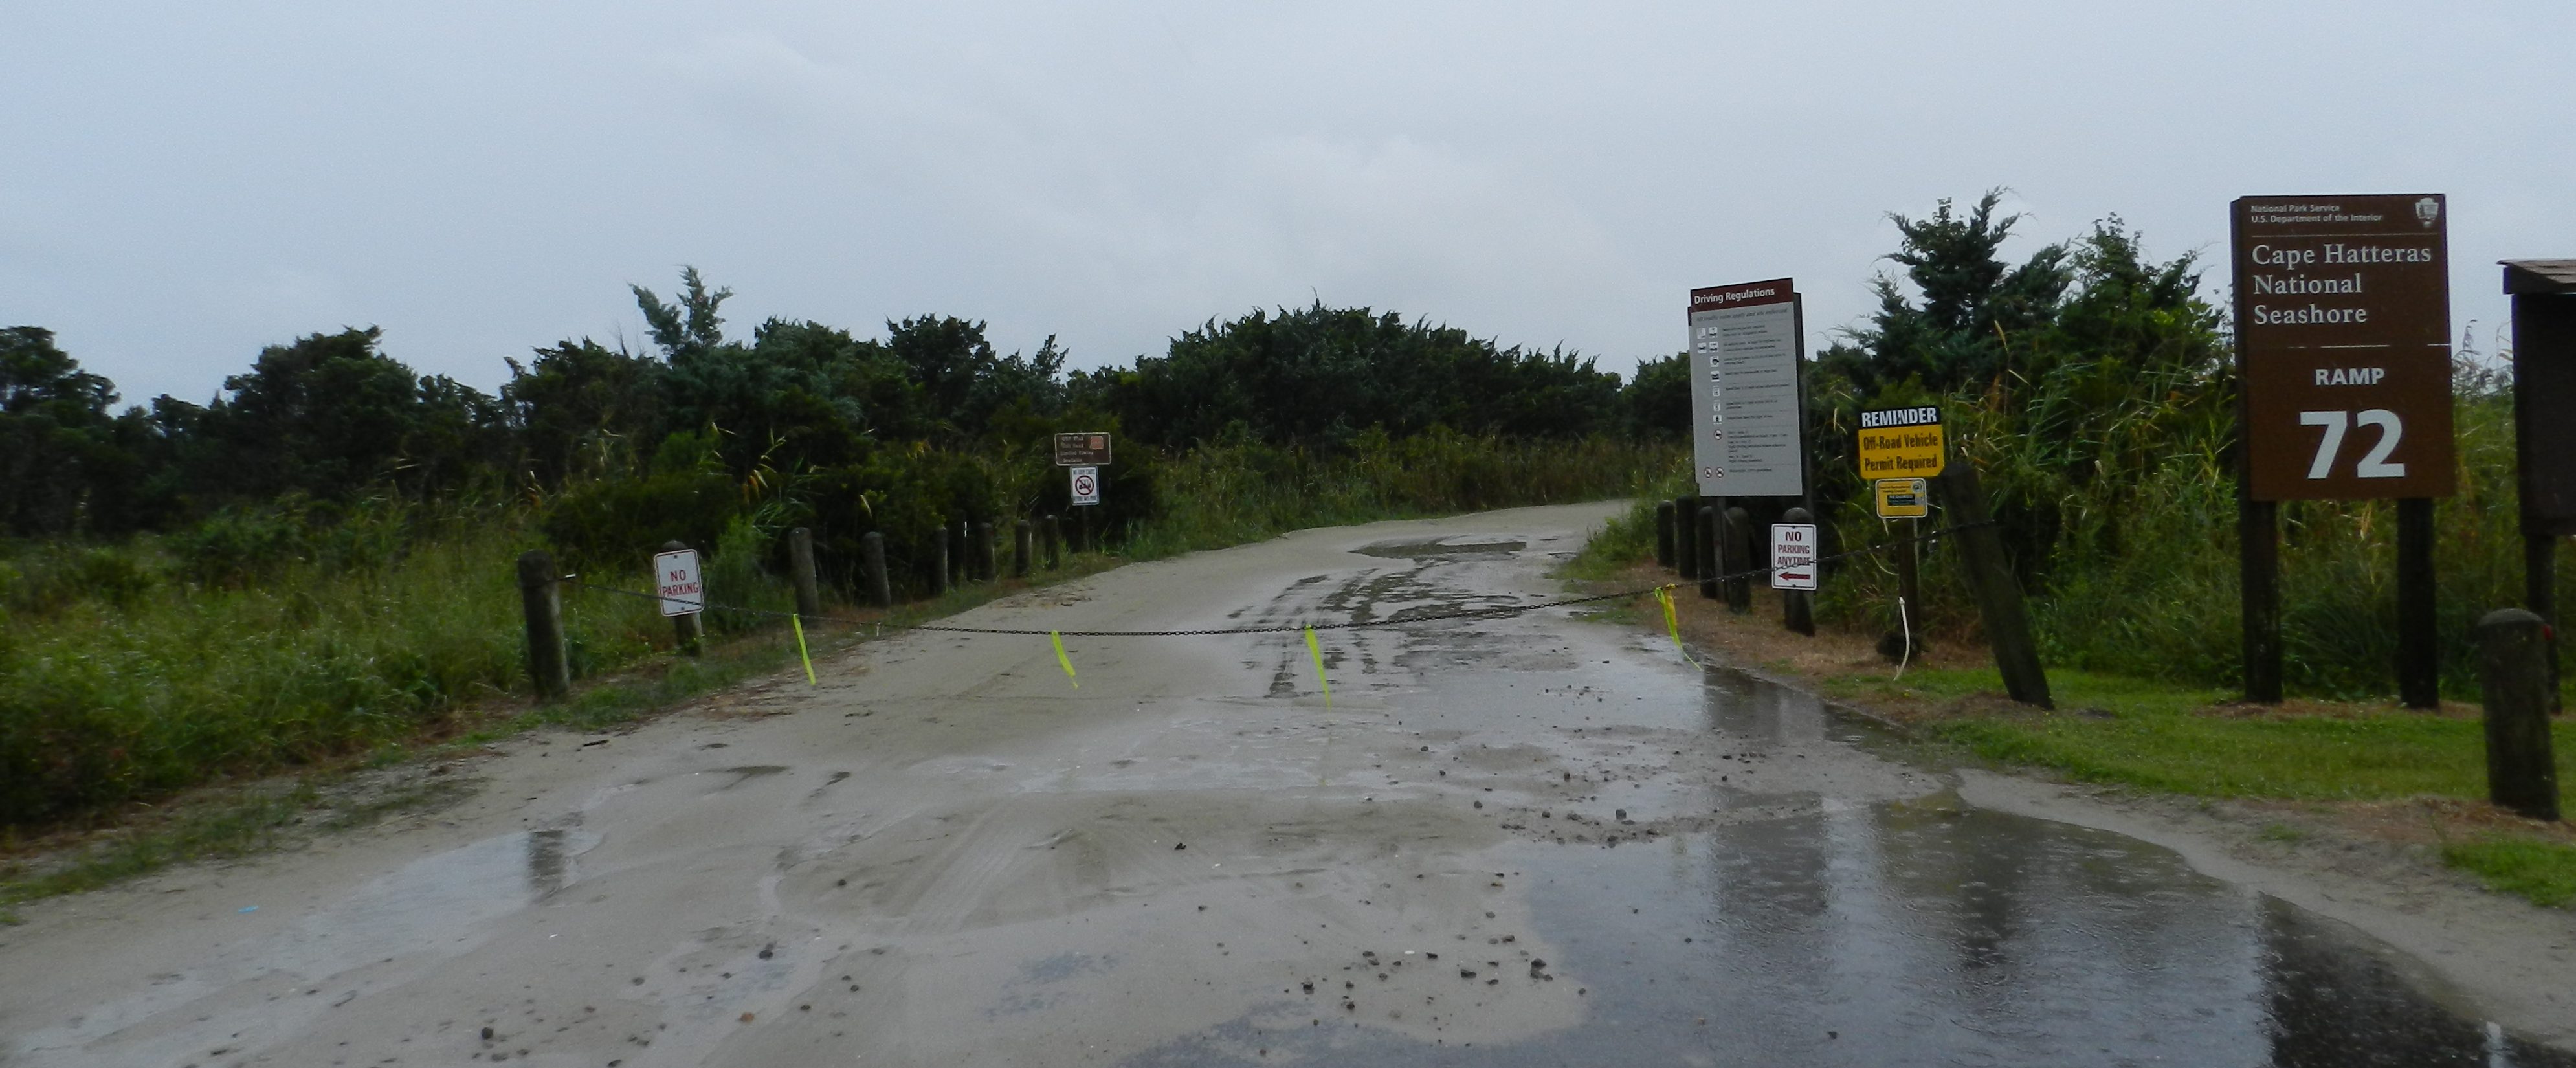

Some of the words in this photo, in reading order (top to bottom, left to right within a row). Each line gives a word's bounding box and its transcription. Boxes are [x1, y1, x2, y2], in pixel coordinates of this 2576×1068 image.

[2251, 204, 2287, 213] National
[2289, 204, 2309, 213] Park
[2310, 203, 2340, 212] Service
[2251, 214, 2268, 223] U.S.
[2271, 214, 2320, 224] Department
[2322, 214, 2332, 222] of
[2333, 214, 2348, 222] the
[2350, 213, 2382, 221] Interior
[2252, 243, 2315, 270] Cape
[2324, 243, 2432, 264] Hatteras
[2252, 273, 2362, 295] National
[1694, 293, 1724, 304] Driving
[1725, 287, 1775, 302] Regulations
[2254, 304, 2368, 324] Seashore
[2315, 367, 2385, 386] RAMP
[1861, 407, 1937, 427] REMINDER
[1863, 436, 1902, 451] Off-Road
[1904, 433, 1938, 448] Vehicle
[2300, 408, 2406, 480] 72
[1865, 456, 1894, 471] Permit
[1896, 454, 1937, 471] Required
[1785, 531, 1802, 542] NO
[1777, 544, 1810, 554] PARKING
[1777, 556, 1810, 566] ANYTIME
[670, 569, 686, 581] NO
[662, 581, 699, 597] PARKING
